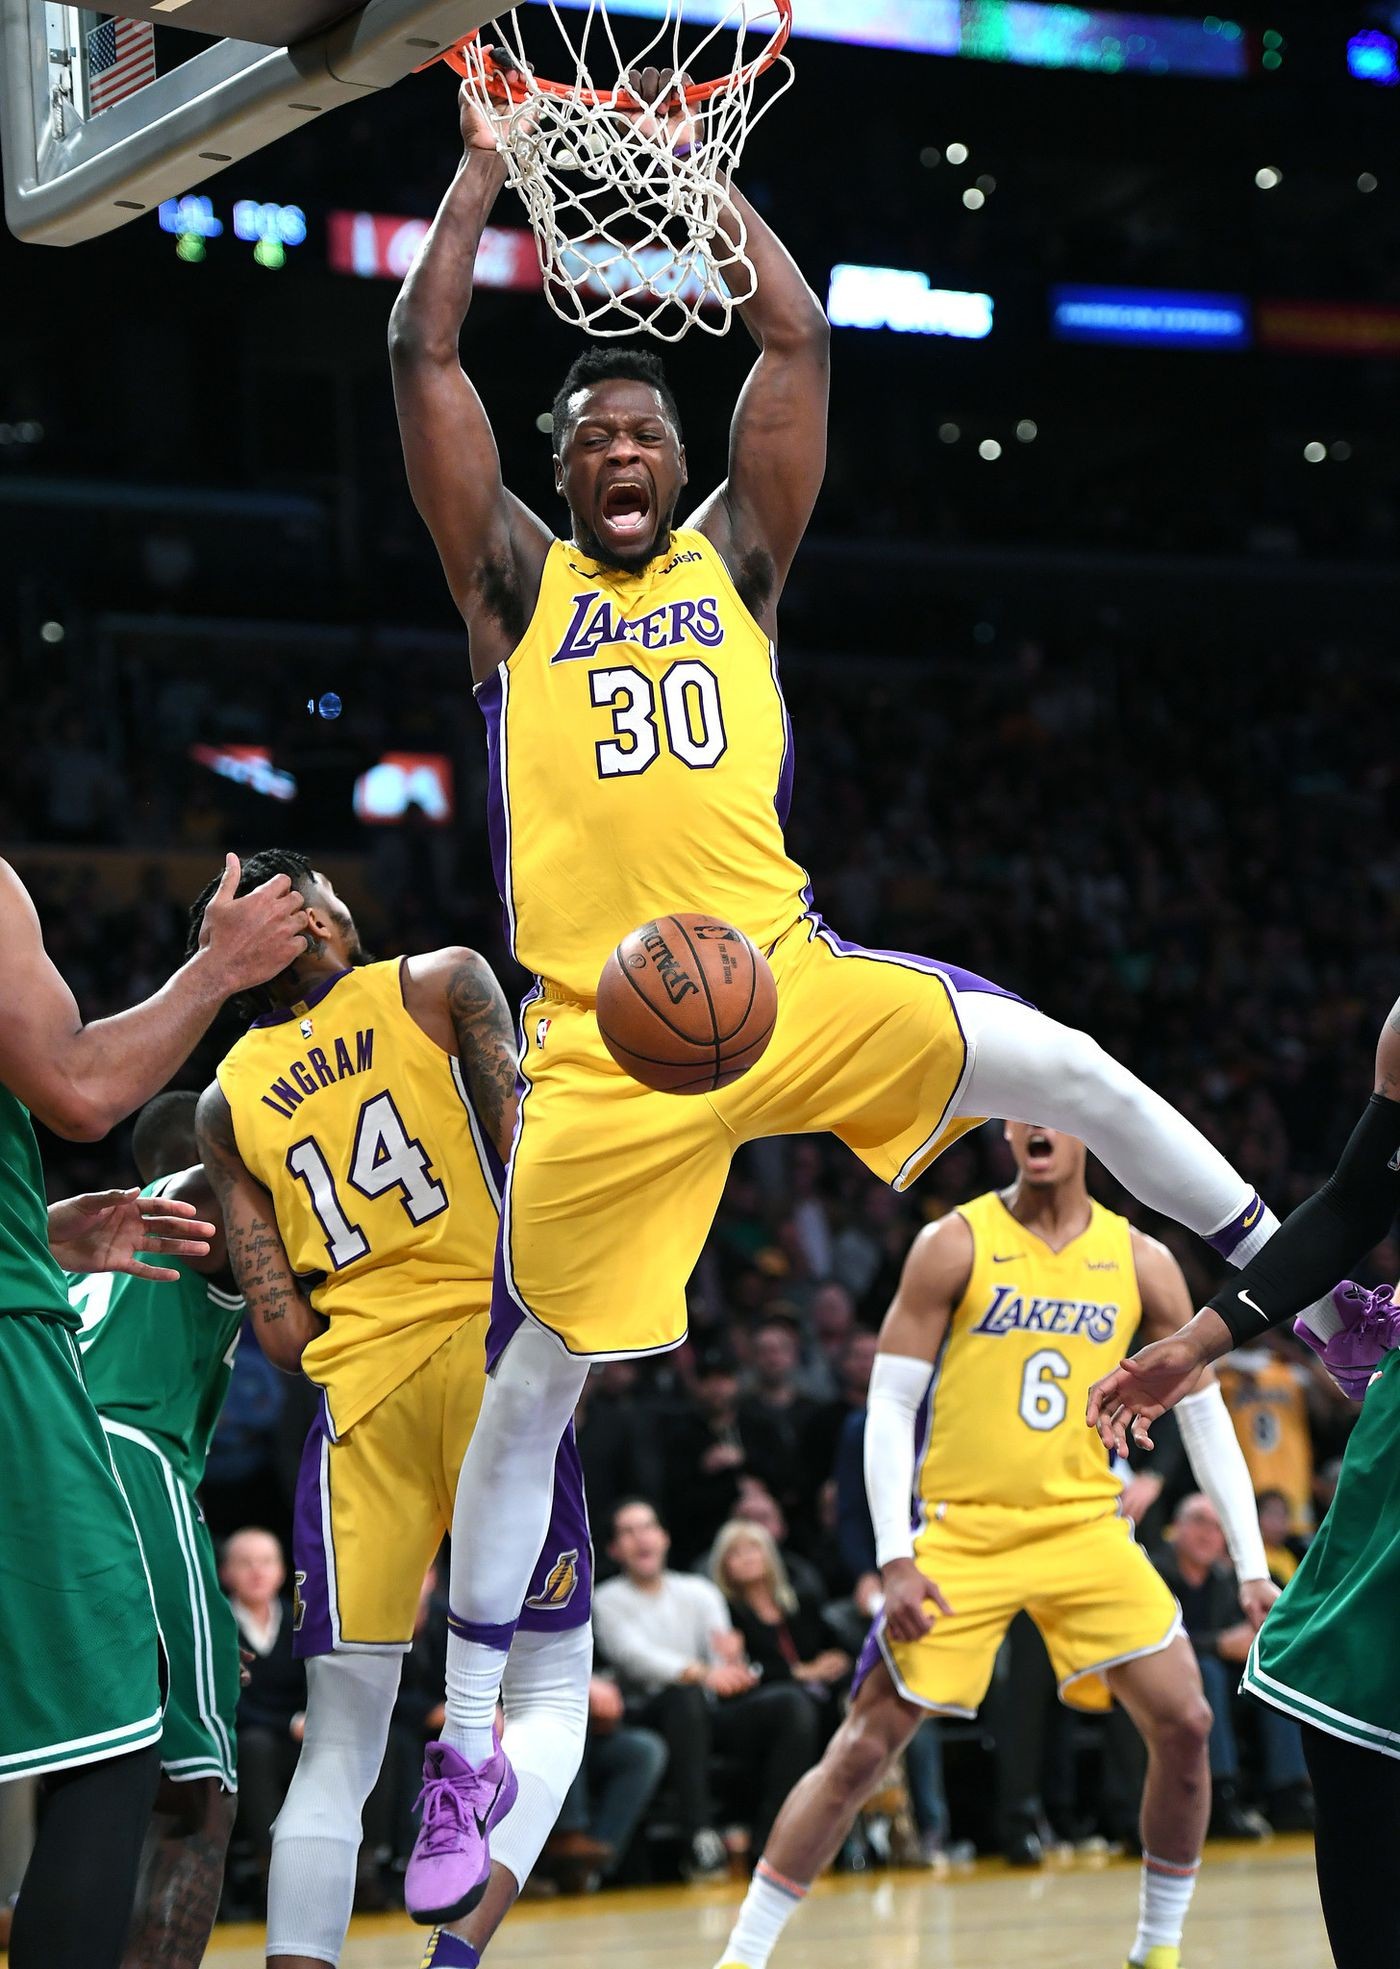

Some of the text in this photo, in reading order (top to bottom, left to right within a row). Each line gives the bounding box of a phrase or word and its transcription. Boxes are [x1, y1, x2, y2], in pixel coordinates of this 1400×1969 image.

[588, 659, 728, 780] 30
[639, 921, 700, 1005] SPALDI
[261, 1028, 374, 1120] INGRAM
[285, 1088, 450, 1272] 14
[970, 1285, 1119, 1343] LAKERS
[1018, 1348, 1071, 1432] 6
